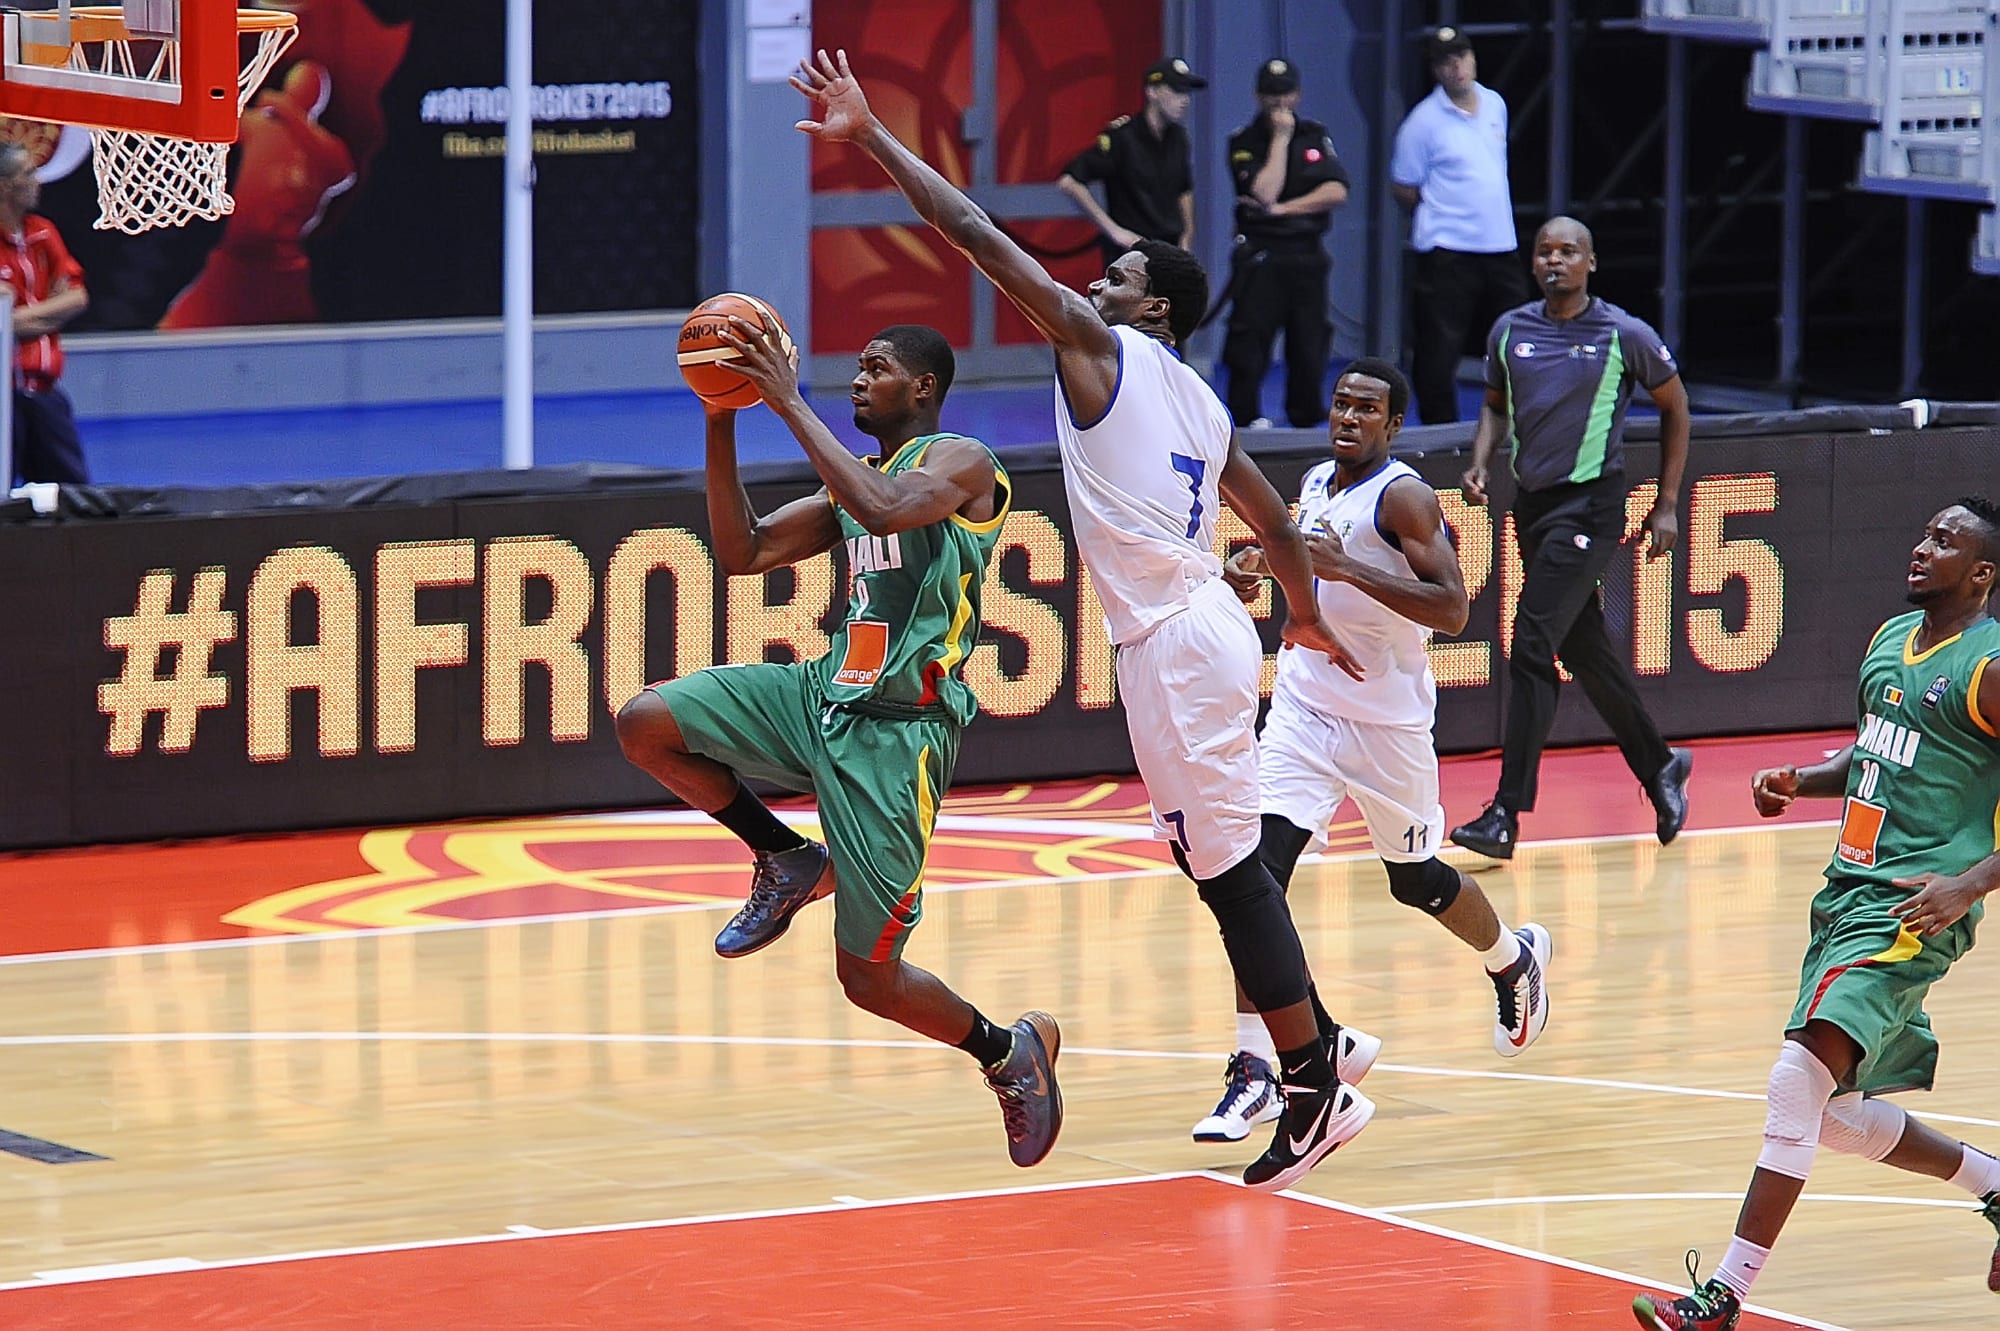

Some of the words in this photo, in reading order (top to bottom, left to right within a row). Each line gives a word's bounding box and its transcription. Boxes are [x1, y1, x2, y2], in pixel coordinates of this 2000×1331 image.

[1170, 451, 1206, 539] 7
[1856, 713, 1921, 768] MALI
[1857, 759, 1880, 800] 10
[1162, 809, 1192, 852] 7
[1403, 824, 1428, 853] 11
